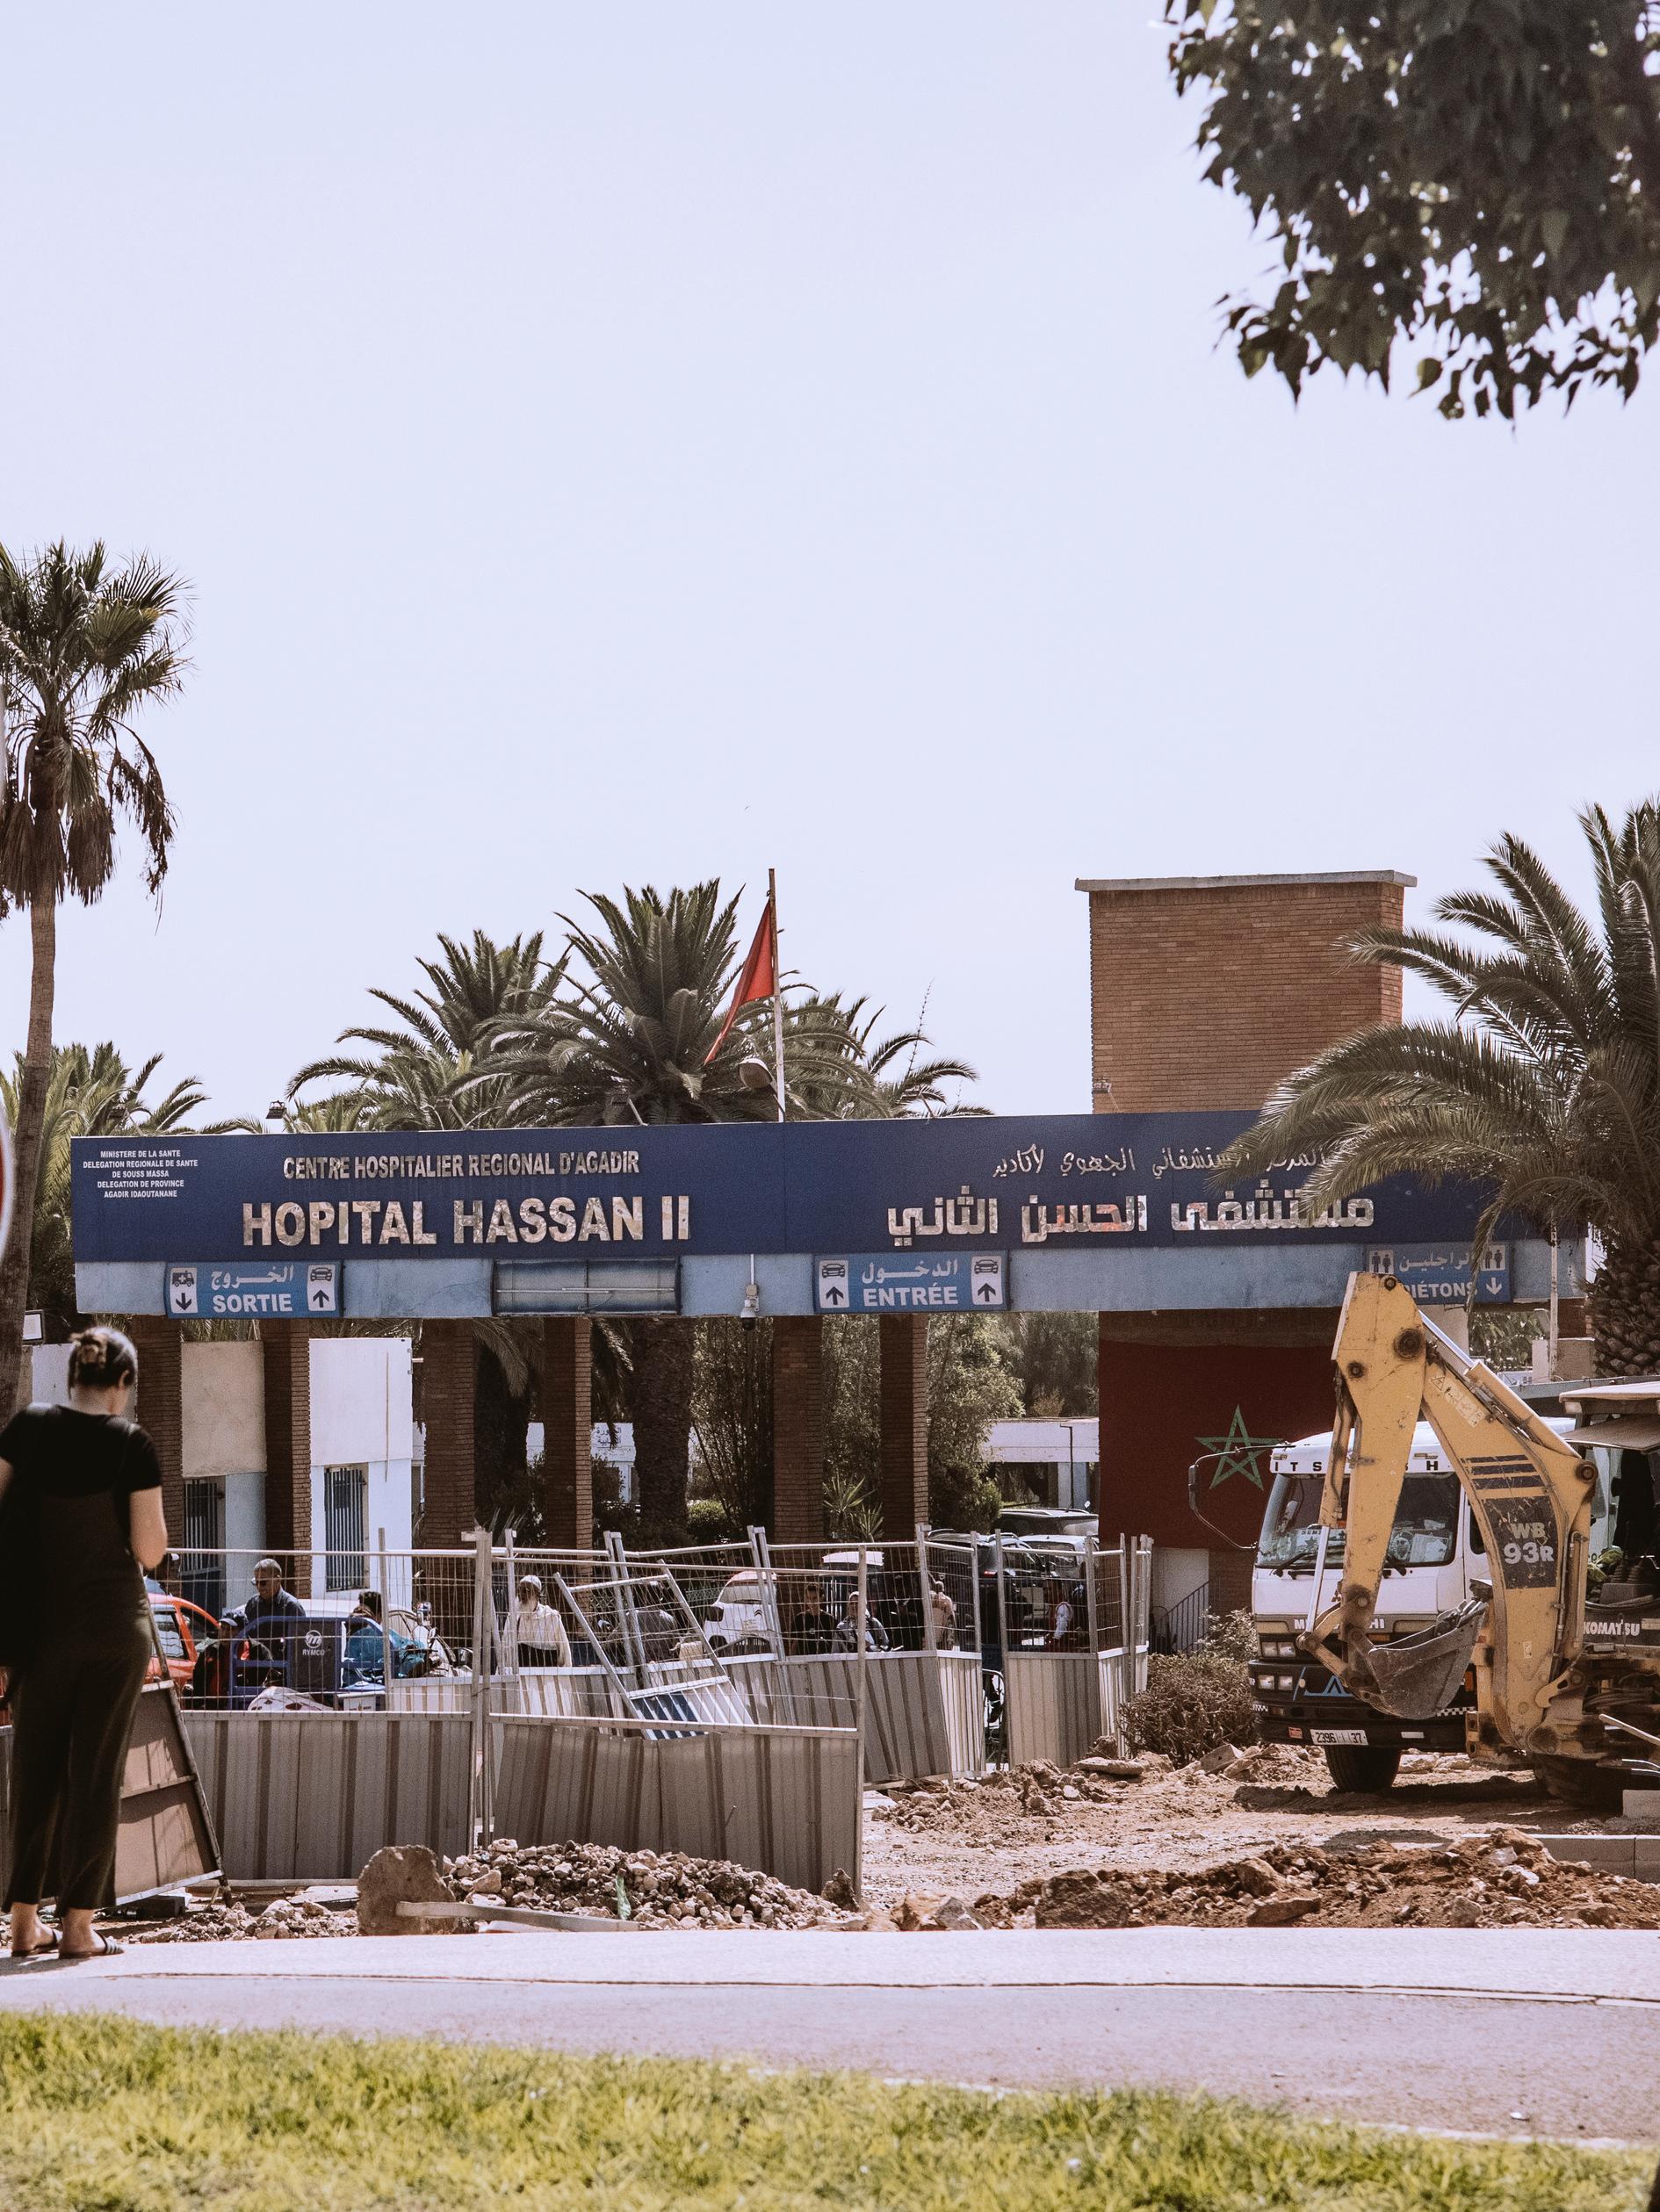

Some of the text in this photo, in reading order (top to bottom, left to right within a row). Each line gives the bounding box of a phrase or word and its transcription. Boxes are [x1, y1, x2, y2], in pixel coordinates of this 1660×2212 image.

[83, 1160, 125, 1169] DELEGATION
[283, 1150, 640, 1179] CENTRE HOSPITALIER REGIONAL D'AGADIR
[1060, 1146, 1136, 1177] الجهوي
[242, 1195, 689, 1246] HOPITAL HASSAN II
[887, 1185, 998, 1246] الثاني
[1021, 1194, 1148, 1243] الحسن
[211, 1265, 294, 1291] الخروج
[862, 1258, 958, 1284] الدخول
[213, 1293, 293, 1313] SORTIE
[862, 1282, 959, 1307] ENTRÉE
[1509, 1522, 1548, 1539] WB
[1503, 1541, 1555, 1565] 93R
[1584, 1619, 1641, 1637] KOMATSU
